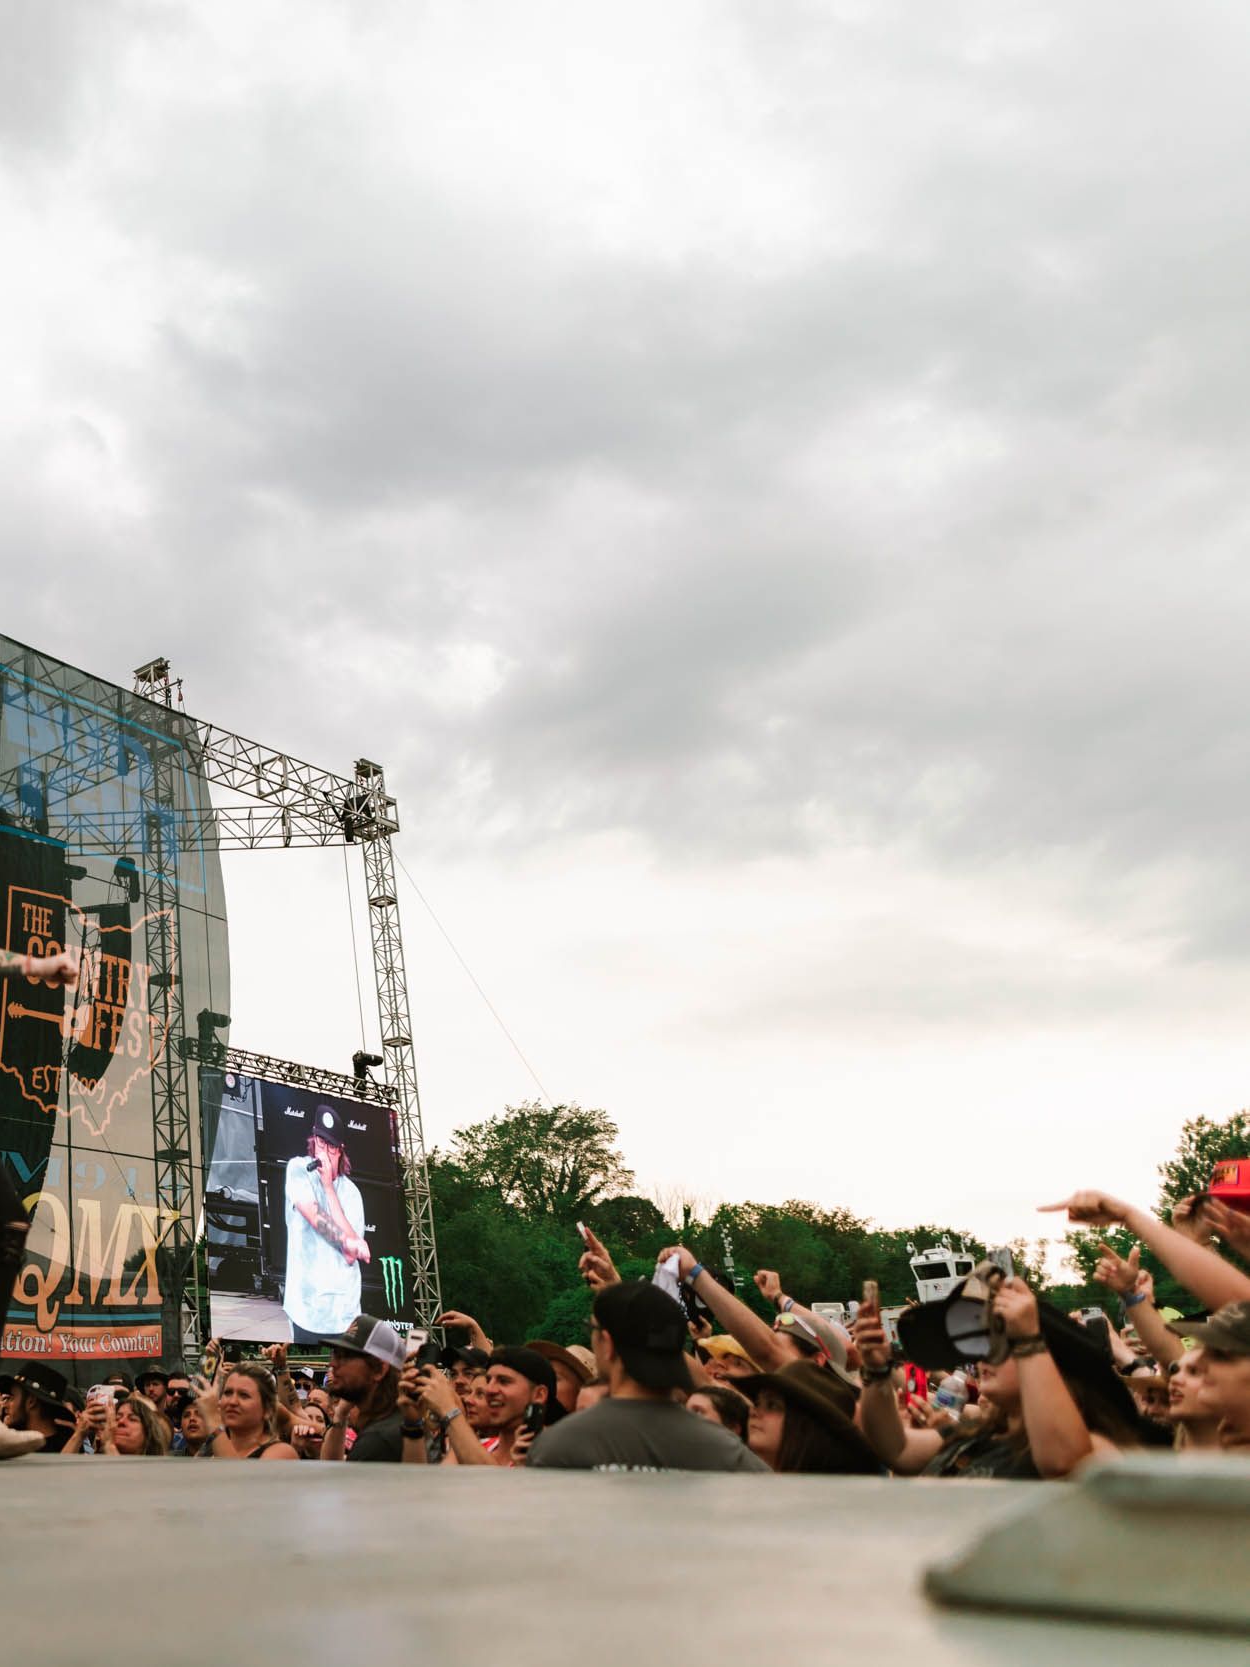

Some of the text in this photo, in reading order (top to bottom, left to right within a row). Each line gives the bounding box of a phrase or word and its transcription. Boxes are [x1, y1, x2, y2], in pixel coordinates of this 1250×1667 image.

[22, 902, 54, 938] THE
[93, 1001, 160, 1062] FEST
[32, 1065, 106, 1104] EST 2009
[0, 1330, 53, 1353] tion!
[59, 1333, 96, 1353] Your
[99, 1332, 160, 1355] Country!
